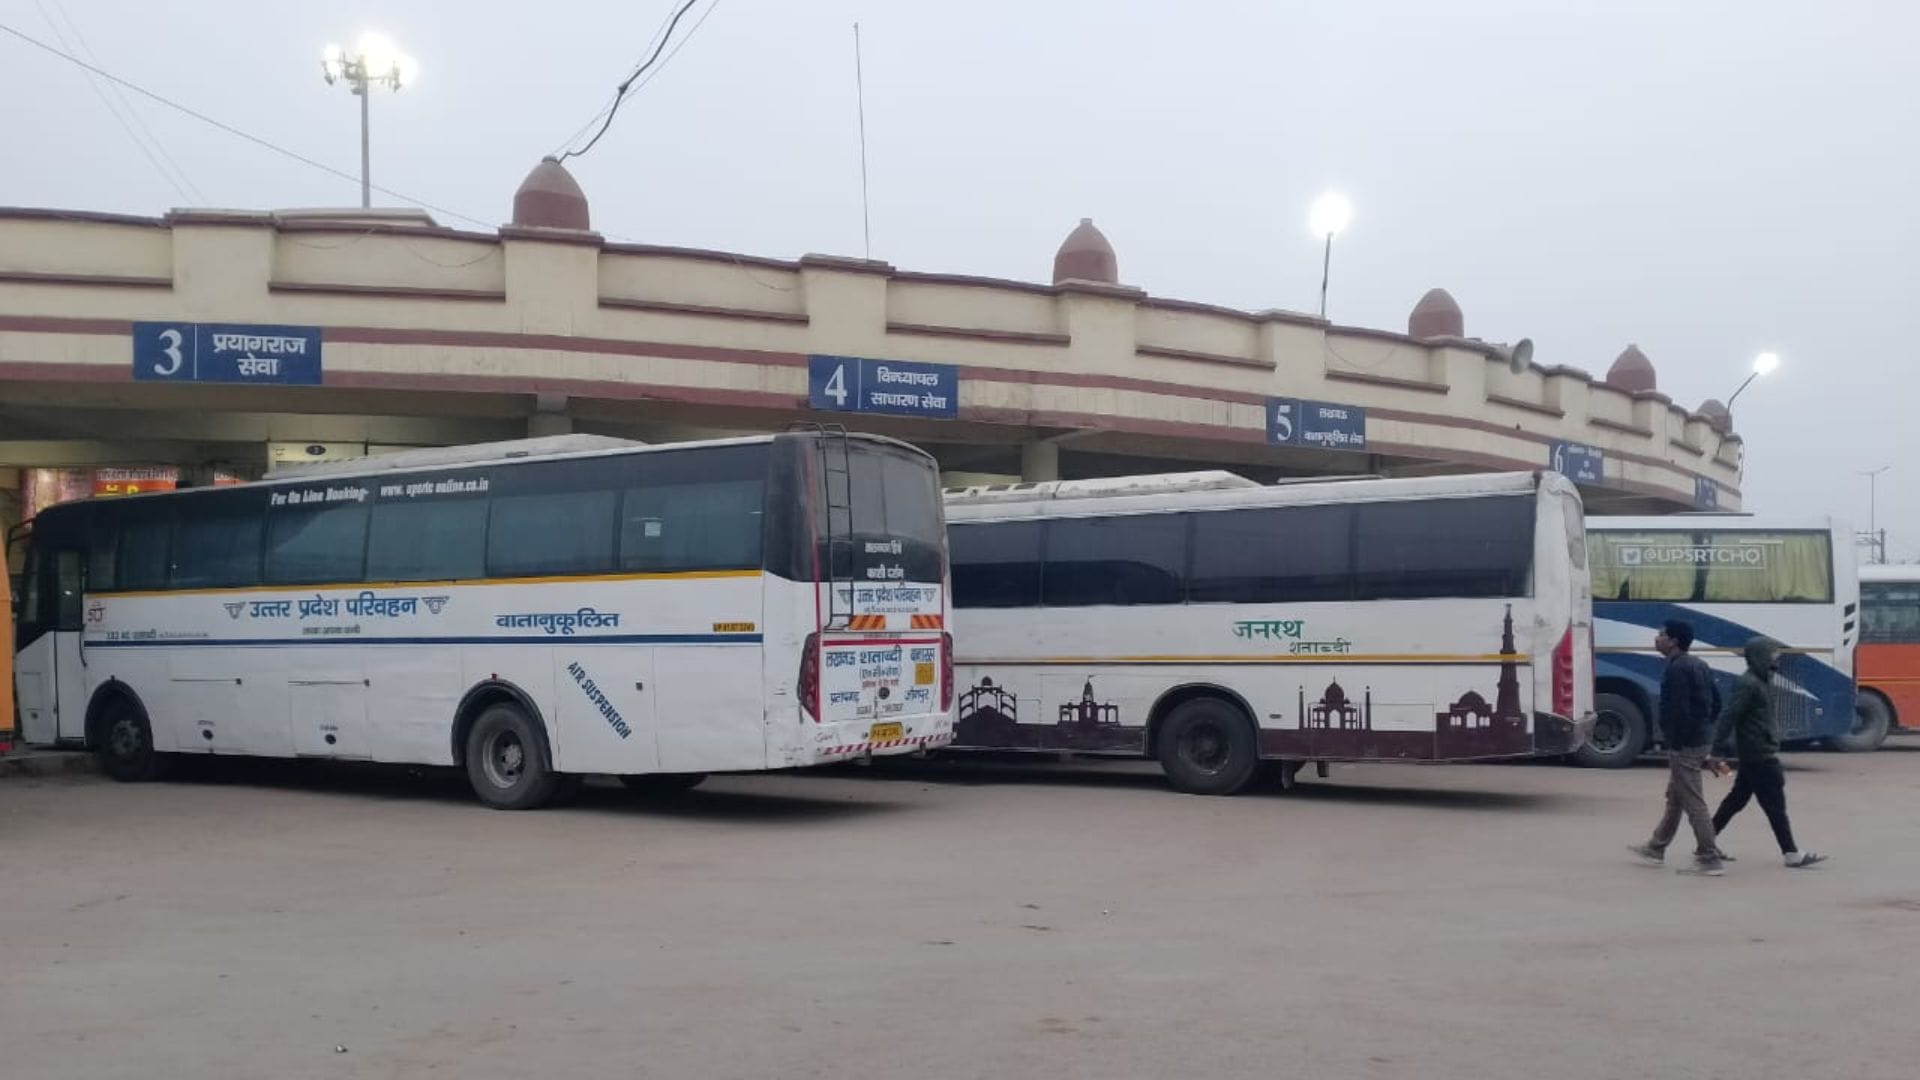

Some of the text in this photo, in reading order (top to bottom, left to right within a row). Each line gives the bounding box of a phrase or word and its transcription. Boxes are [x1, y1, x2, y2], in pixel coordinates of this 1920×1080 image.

[153, 329, 182, 375] 3
[212, 333, 307, 354] प्रयागराज
[237, 352, 279, 376] सेवा
[824, 364, 848, 406] 4
[870, 392, 947, 409] साधारण सेवा
[1277, 405, 1292, 441] 5
[1554, 444, 1564, 473] 6
[271, 492, 286, 505] For
[302, 489, 323, 502] Line
[250, 591, 418, 619] उत्तर प्रदेश परिवहन
[495, 607, 619, 634] वातानुकूलित
[1232, 620, 1304, 639] जनरथ
[825, 650, 856, 667] लखनऊ
[859, 644, 902, 664] शताब्दी
[567, 661, 632, 740] AIR SUSPENSION
